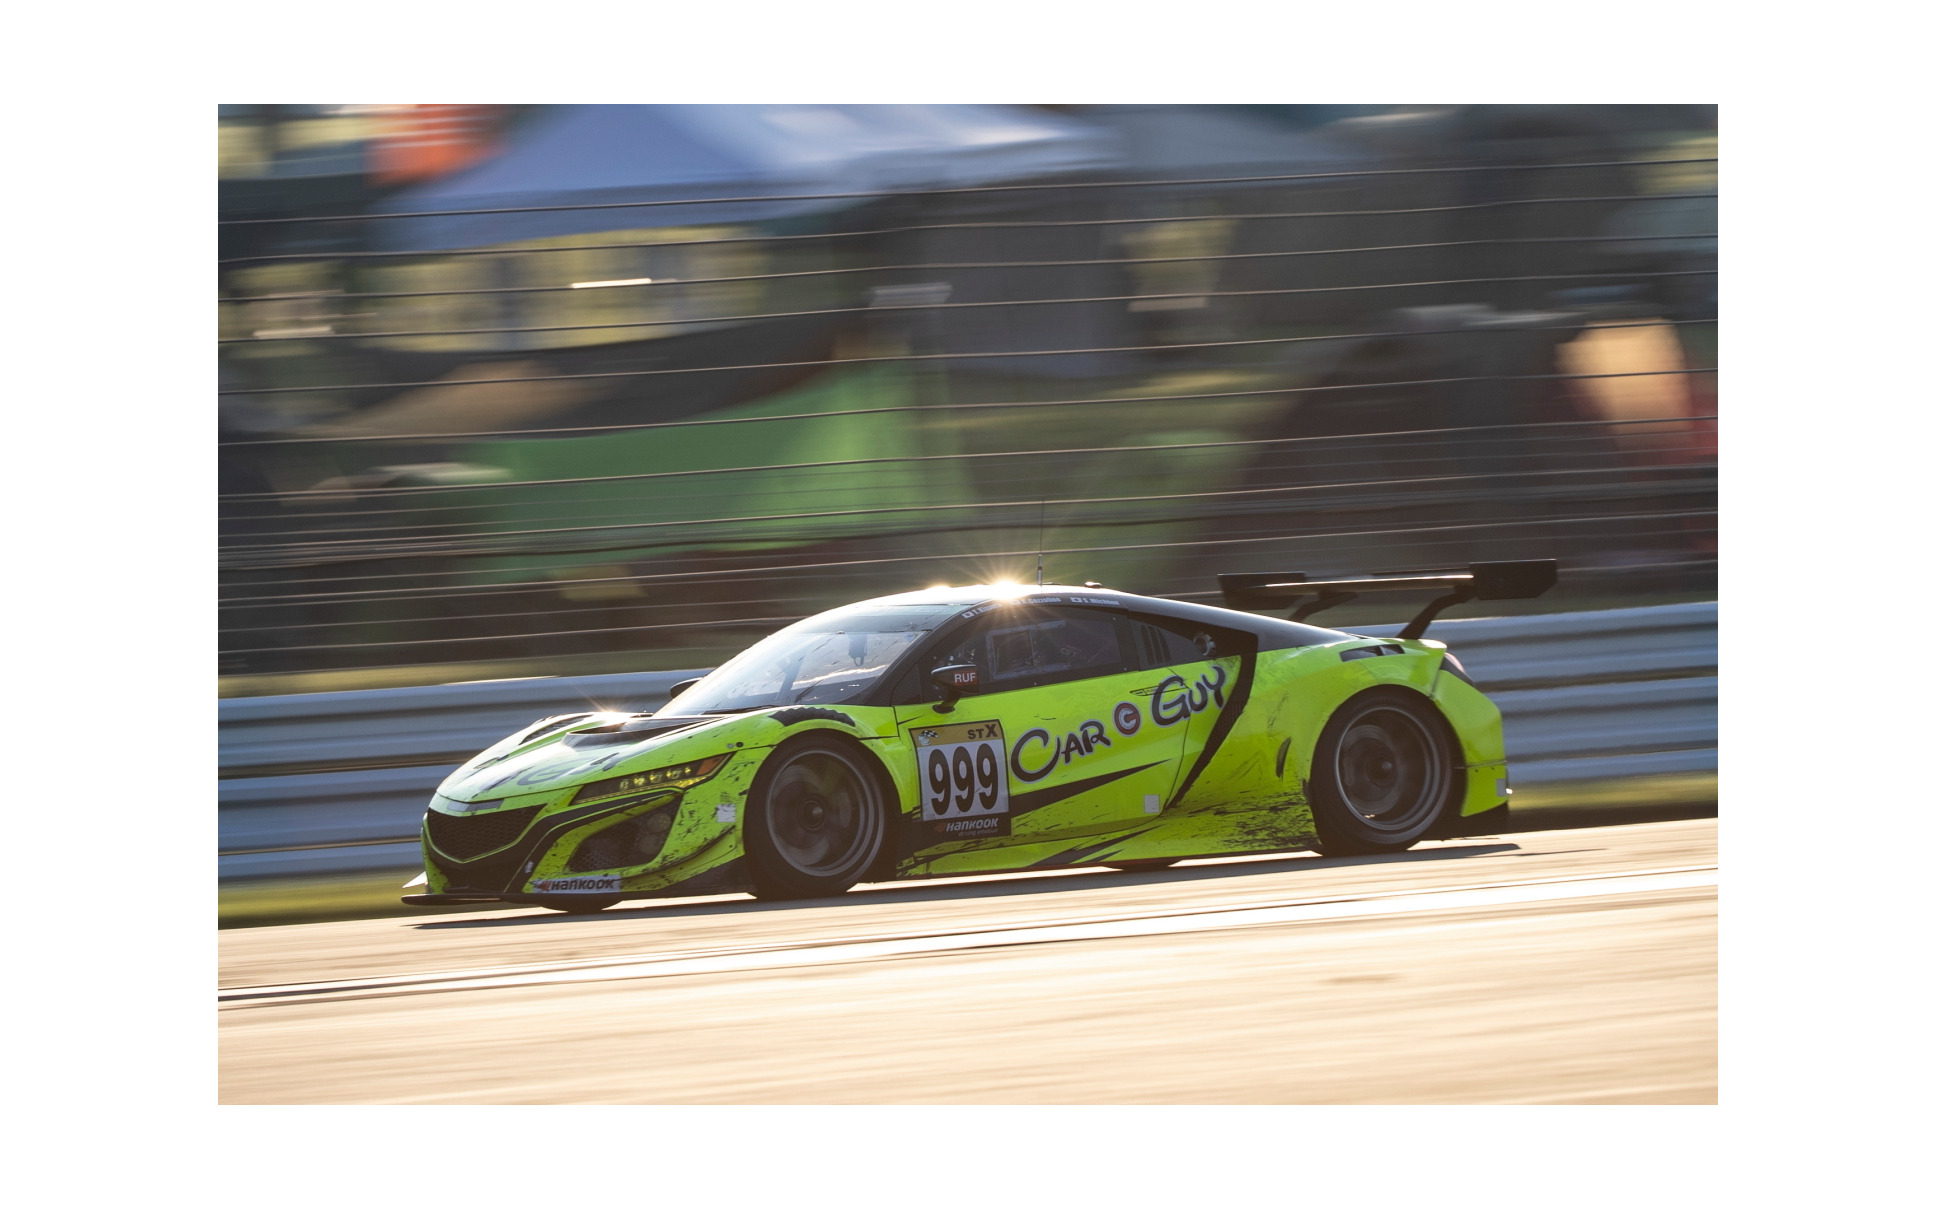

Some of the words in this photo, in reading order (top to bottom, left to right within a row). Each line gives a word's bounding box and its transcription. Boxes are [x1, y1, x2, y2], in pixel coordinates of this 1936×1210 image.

[953, 672, 976, 685] RUF
[967, 723, 998, 740] STX
[1010, 720, 1112, 784] CAR
[1151, 665, 1228, 727] GUY
[928, 743, 999, 816] 999
